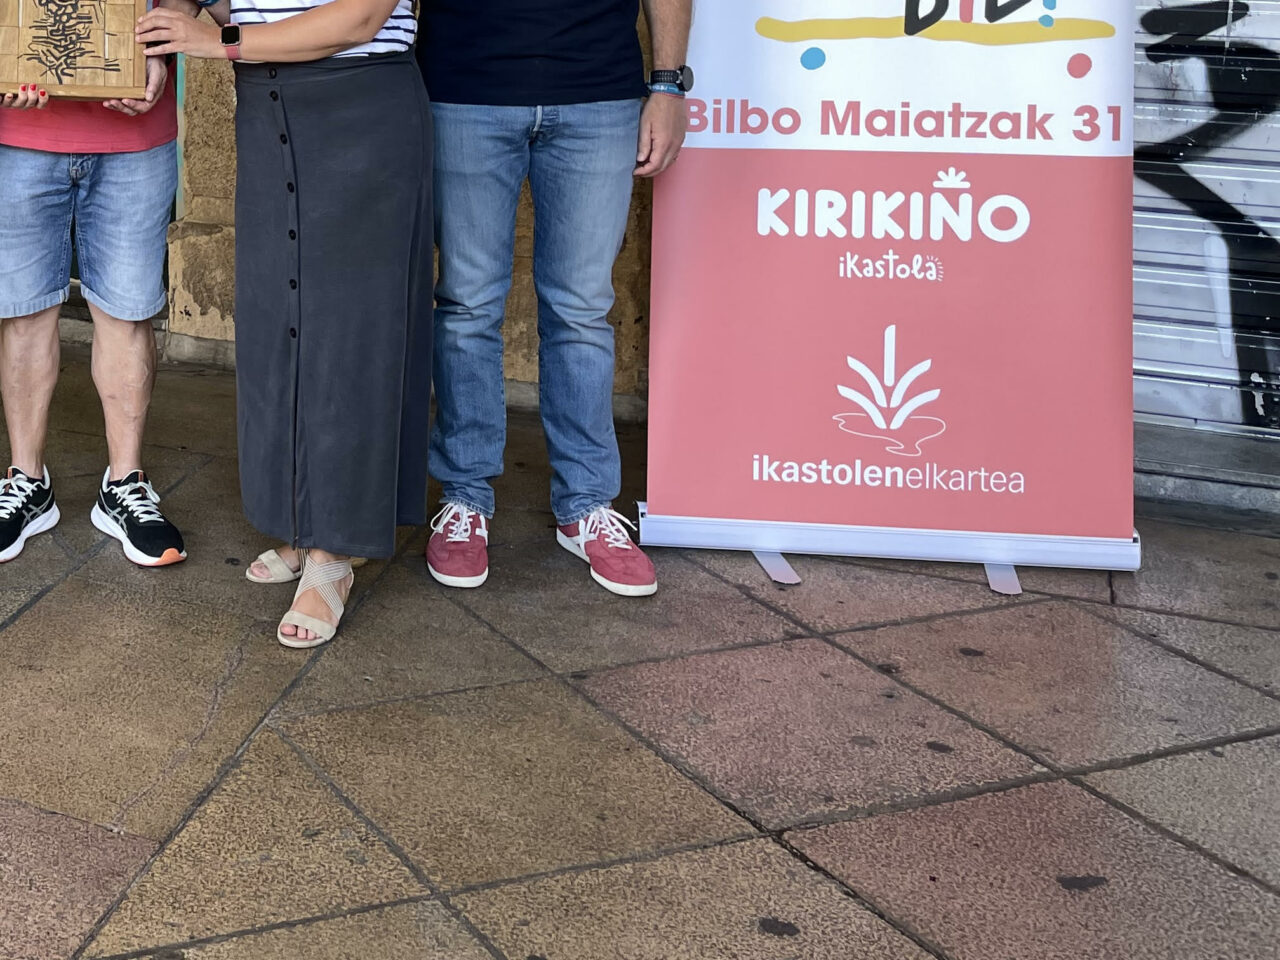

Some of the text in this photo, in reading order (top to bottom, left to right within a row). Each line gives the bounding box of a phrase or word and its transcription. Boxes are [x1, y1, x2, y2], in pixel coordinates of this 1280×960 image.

[685, 98, 1122, 142] Bilbo Maiatzak 31
[752, 454, 1025, 494] ikastolenelkartea
